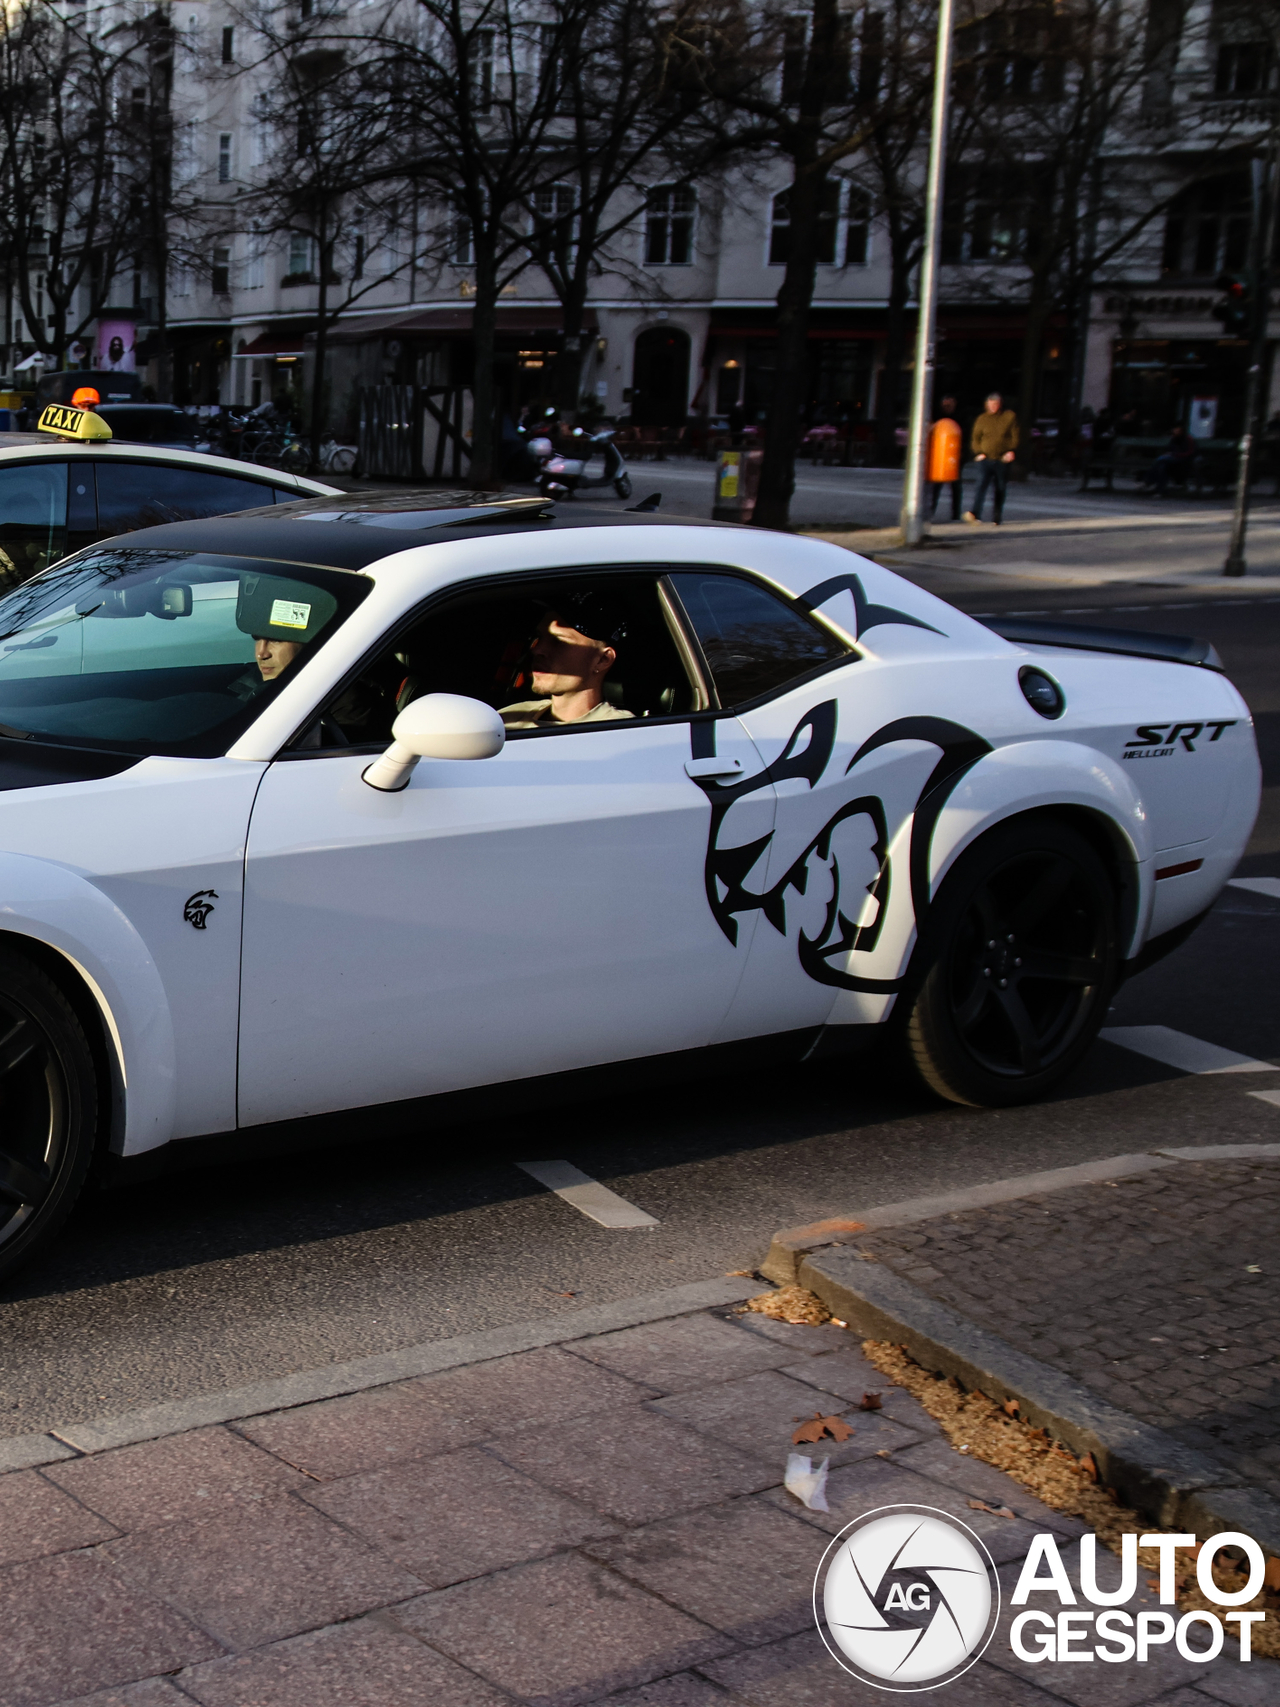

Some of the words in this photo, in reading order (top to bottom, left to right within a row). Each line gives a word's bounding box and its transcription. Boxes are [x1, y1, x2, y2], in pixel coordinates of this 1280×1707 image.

[44, 405, 83, 431] TAXI
[1124, 720, 1239, 753] SRT
[1122, 747, 1177, 760] HELLCAT
